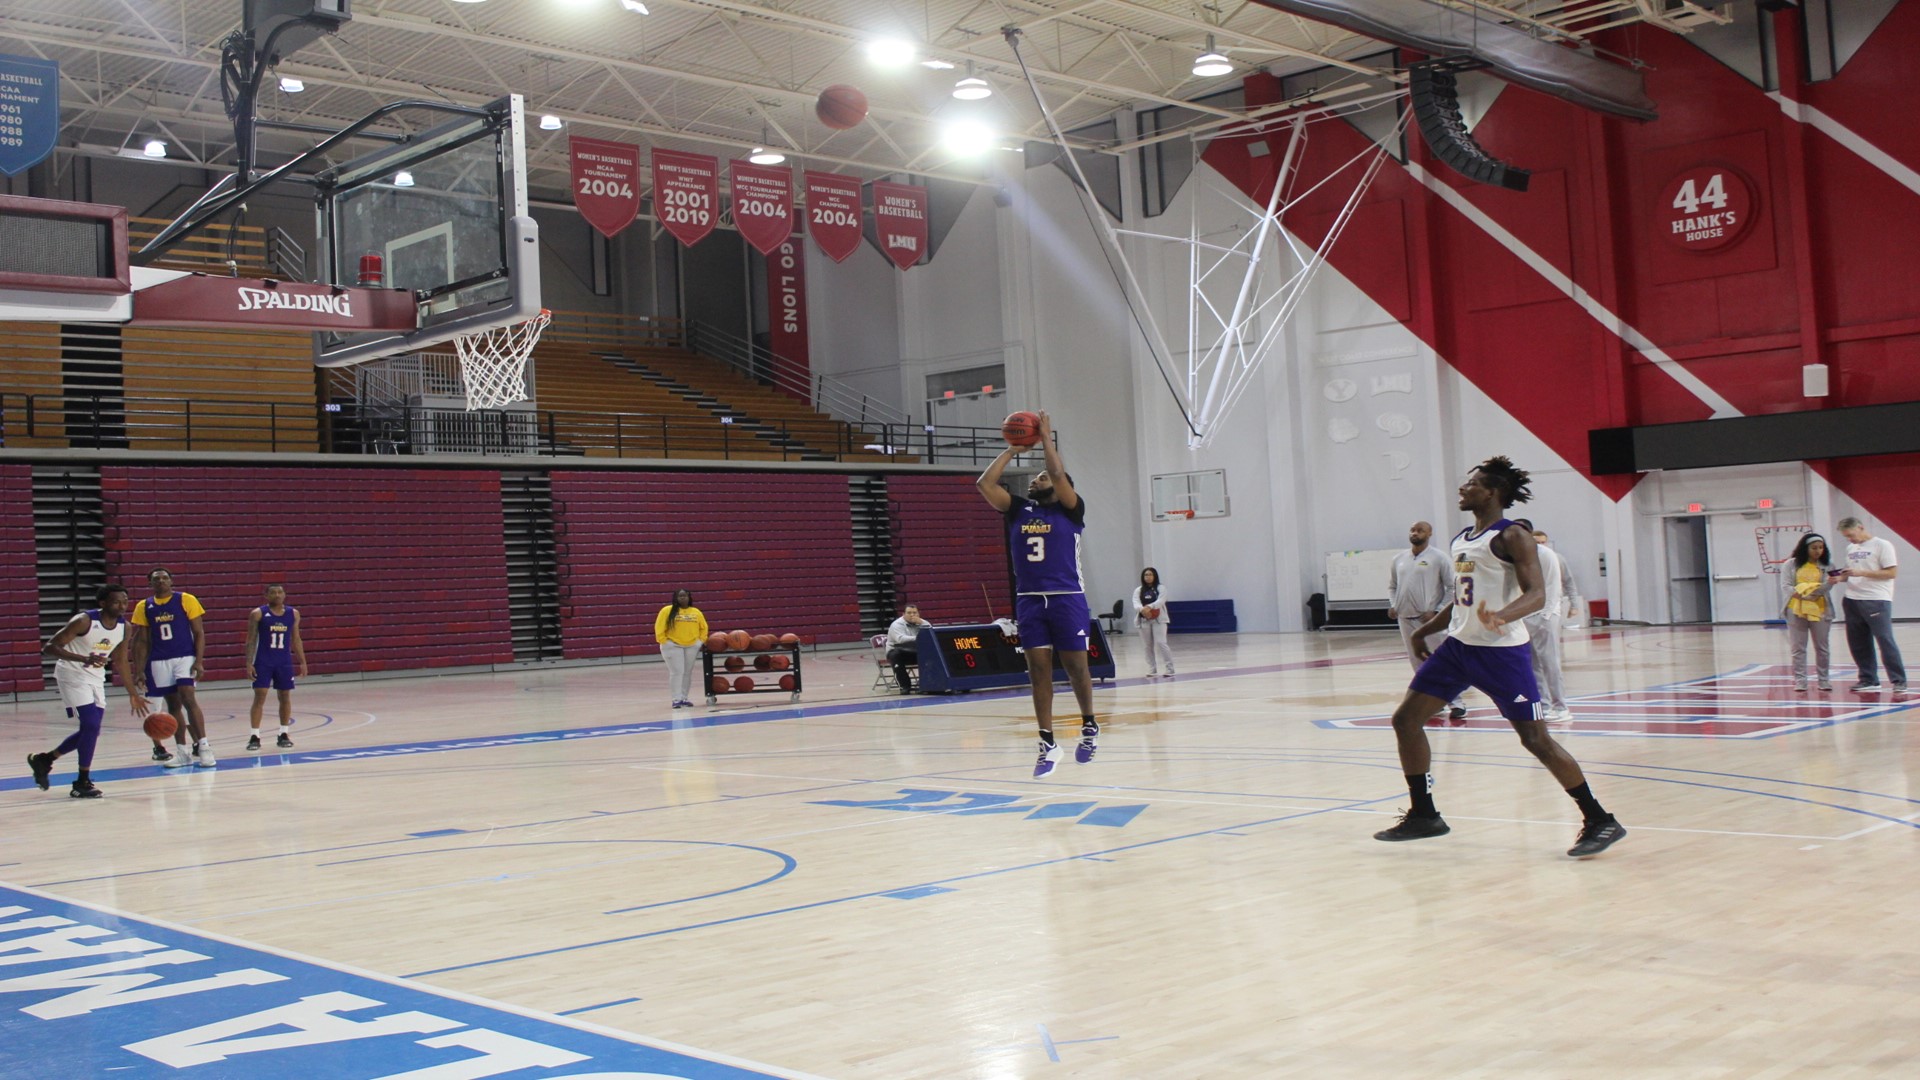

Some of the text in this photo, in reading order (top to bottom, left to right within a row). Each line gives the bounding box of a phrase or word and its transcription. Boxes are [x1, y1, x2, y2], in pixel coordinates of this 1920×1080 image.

[577, 152, 632, 166] WOMEN'S BASKETBALL
[584, 169, 627, 180] TOURNAMENT
[596, 164, 614, 172] NCAA
[659, 163, 711, 177] WOMEN'S BASKETBALL
[579, 178, 633, 199] 2004
[666, 180, 706, 190] APPEARANCE
[736, 175, 786, 187] WOMEN'S BASKETBALL
[745, 191, 779, 200] CHAMPIONS
[749, 185, 787, 195] TOURNAMENT
[830, 188, 856, 197] BASKETBALL
[1672, 173, 1728, 214] 44
[663, 188, 709, 209] 2001
[819, 201, 850, 210] CHAMPIONS
[884, 196, 916, 209] WOMEN'S
[664, 206, 709, 226] 2019
[739, 198, 787, 219] 2004
[878, 205, 924, 219] BASKETBALL
[812, 208, 858, 228] 2004
[1672, 211, 1736, 233] HANK'S
[1686, 227, 1723, 242] HOUSE
[888, 234, 917, 251] LMU
[780, 242, 798, 333] GO LIONS
[238, 286, 352, 317] SPALDING
[1370, 373, 1413, 397] LMU
[325, 403, 341, 412] 303
[720, 416, 733, 424] 304
[1026, 536, 1045, 562] 3
[160, 623, 173, 640] 0
[270, 633, 285, 649] 11
[954, 636, 982, 650] HOME
[963, 653, 977, 668] 0
